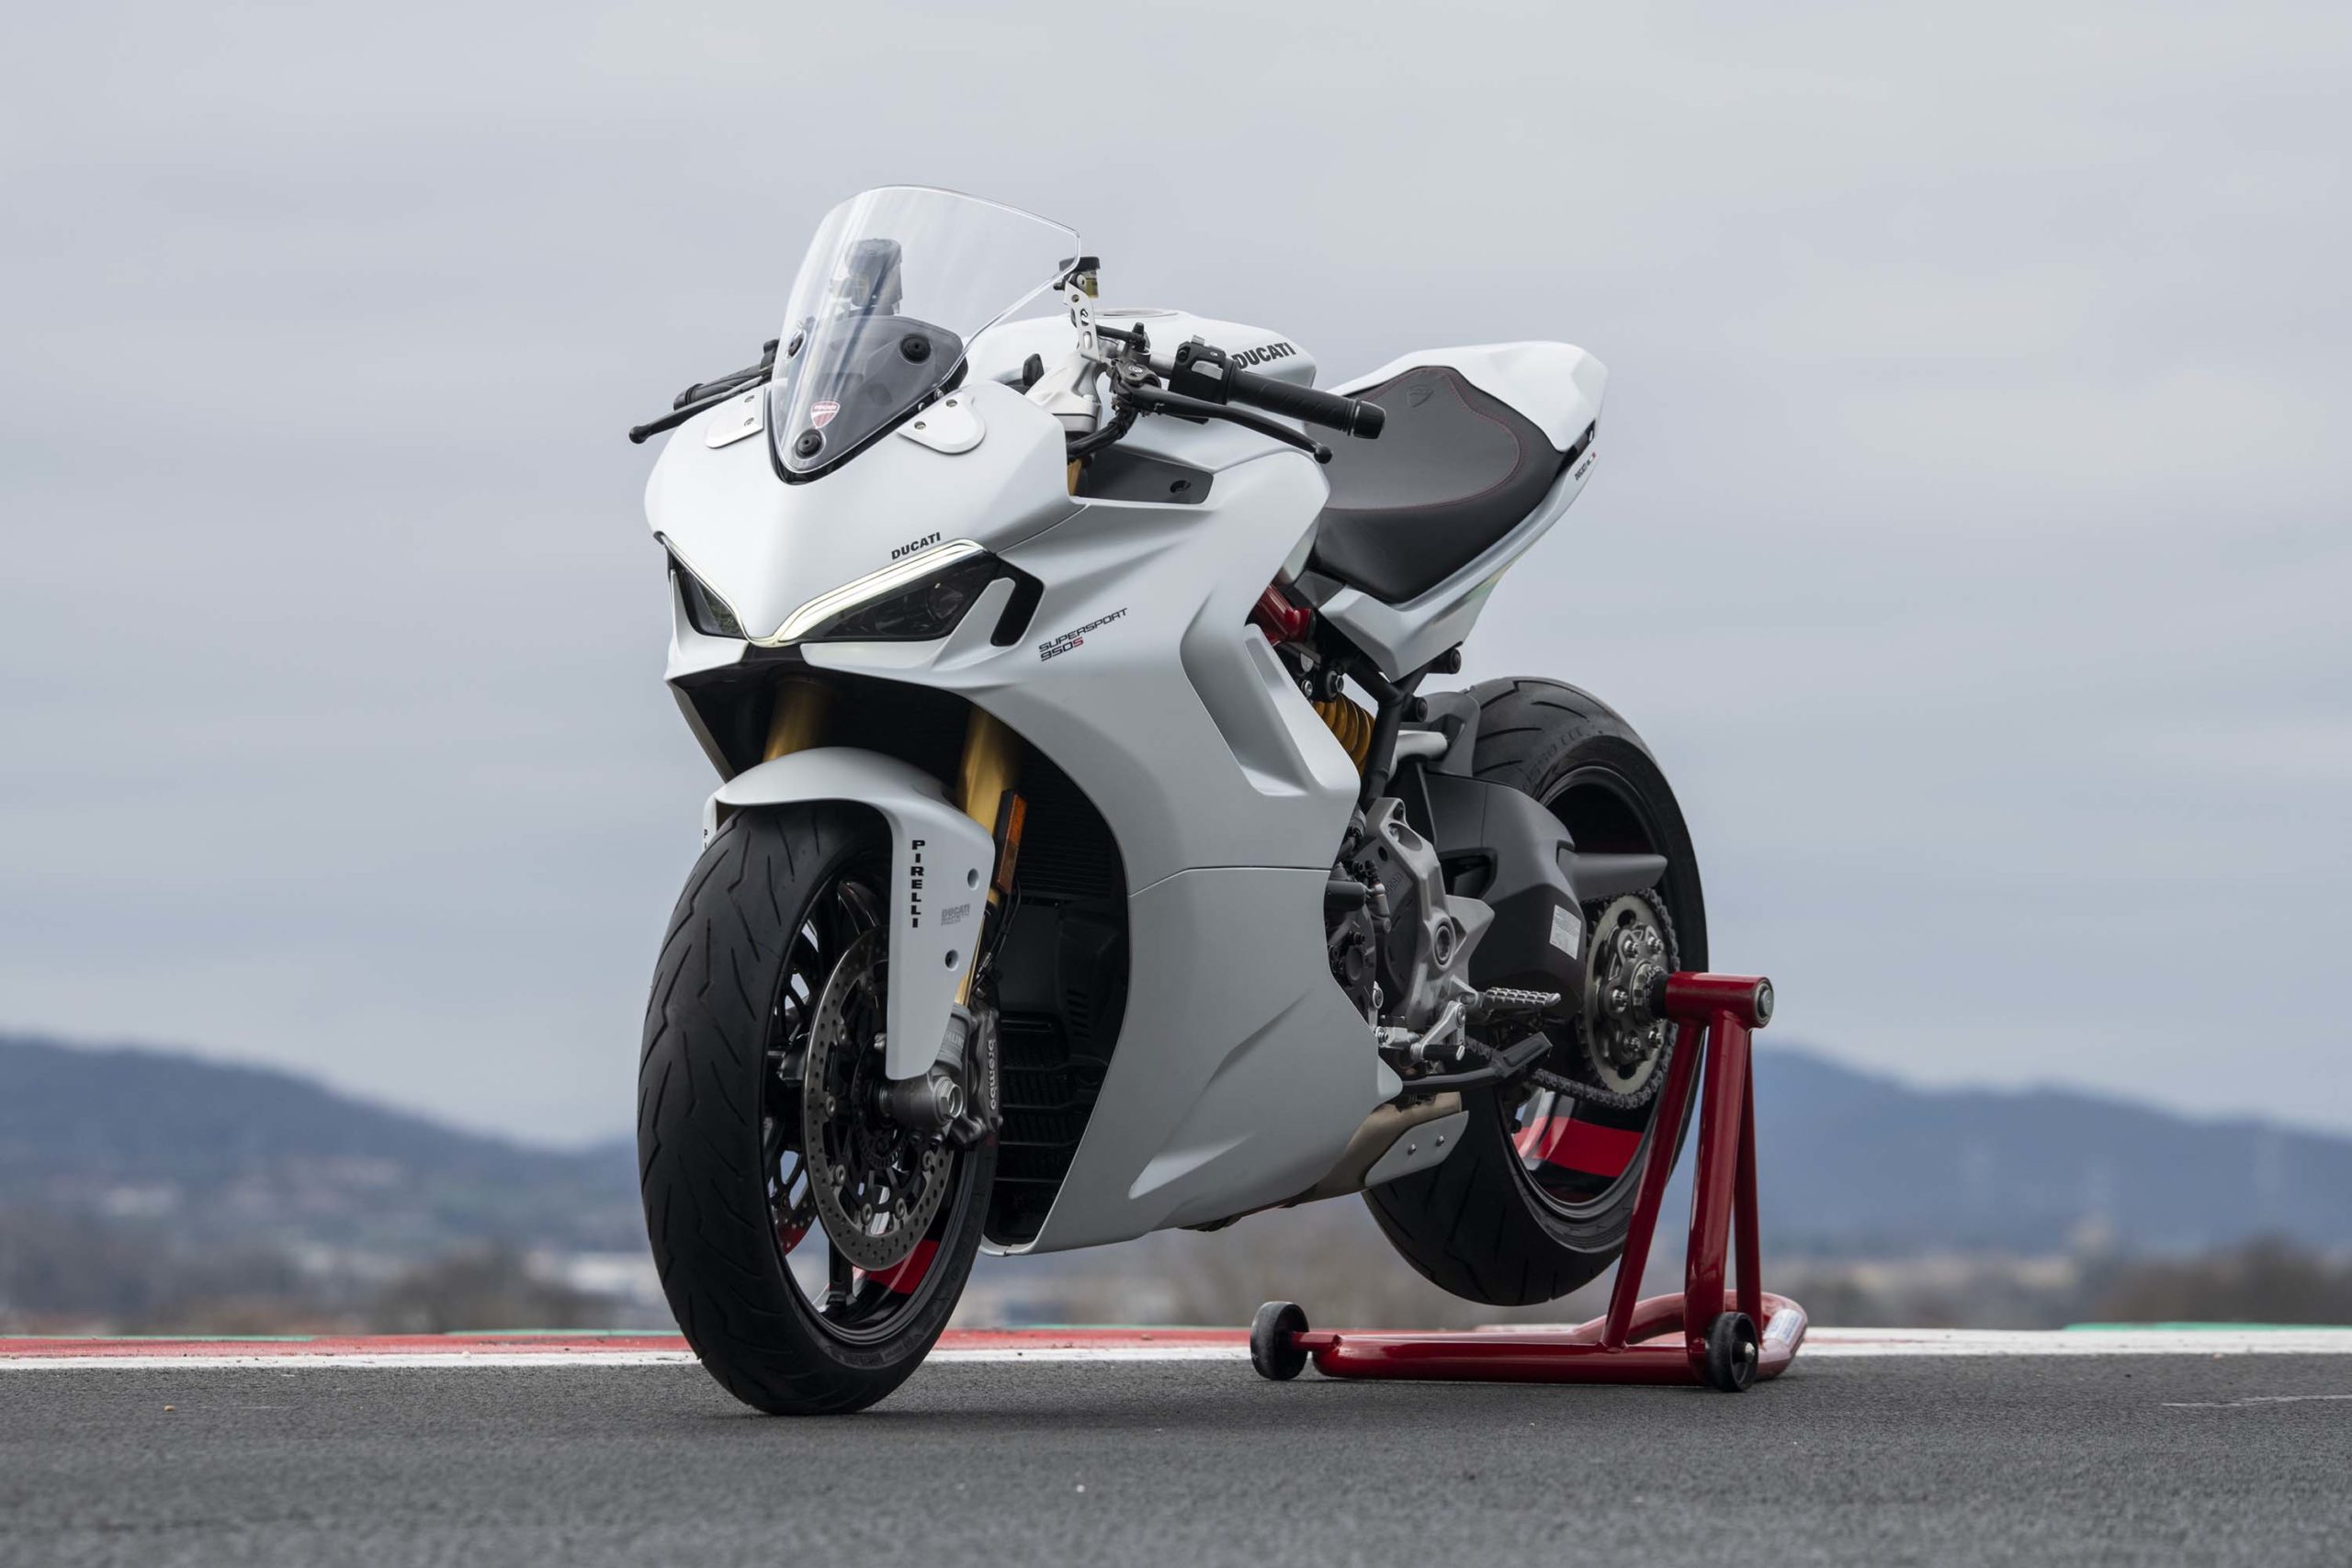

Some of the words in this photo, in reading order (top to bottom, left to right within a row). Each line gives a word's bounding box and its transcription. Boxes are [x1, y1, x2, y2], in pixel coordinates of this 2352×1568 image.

[1231, 342, 1296, 369] DUCATI
[891, 532, 941, 560] DUCATI
[1038, 607, 1127, 653] SUPERSPORT
[1040, 637, 1084, 662] 950S
[910, 840, 925, 928] PIRELLI
[988, 1039, 997, 1110] brembo
